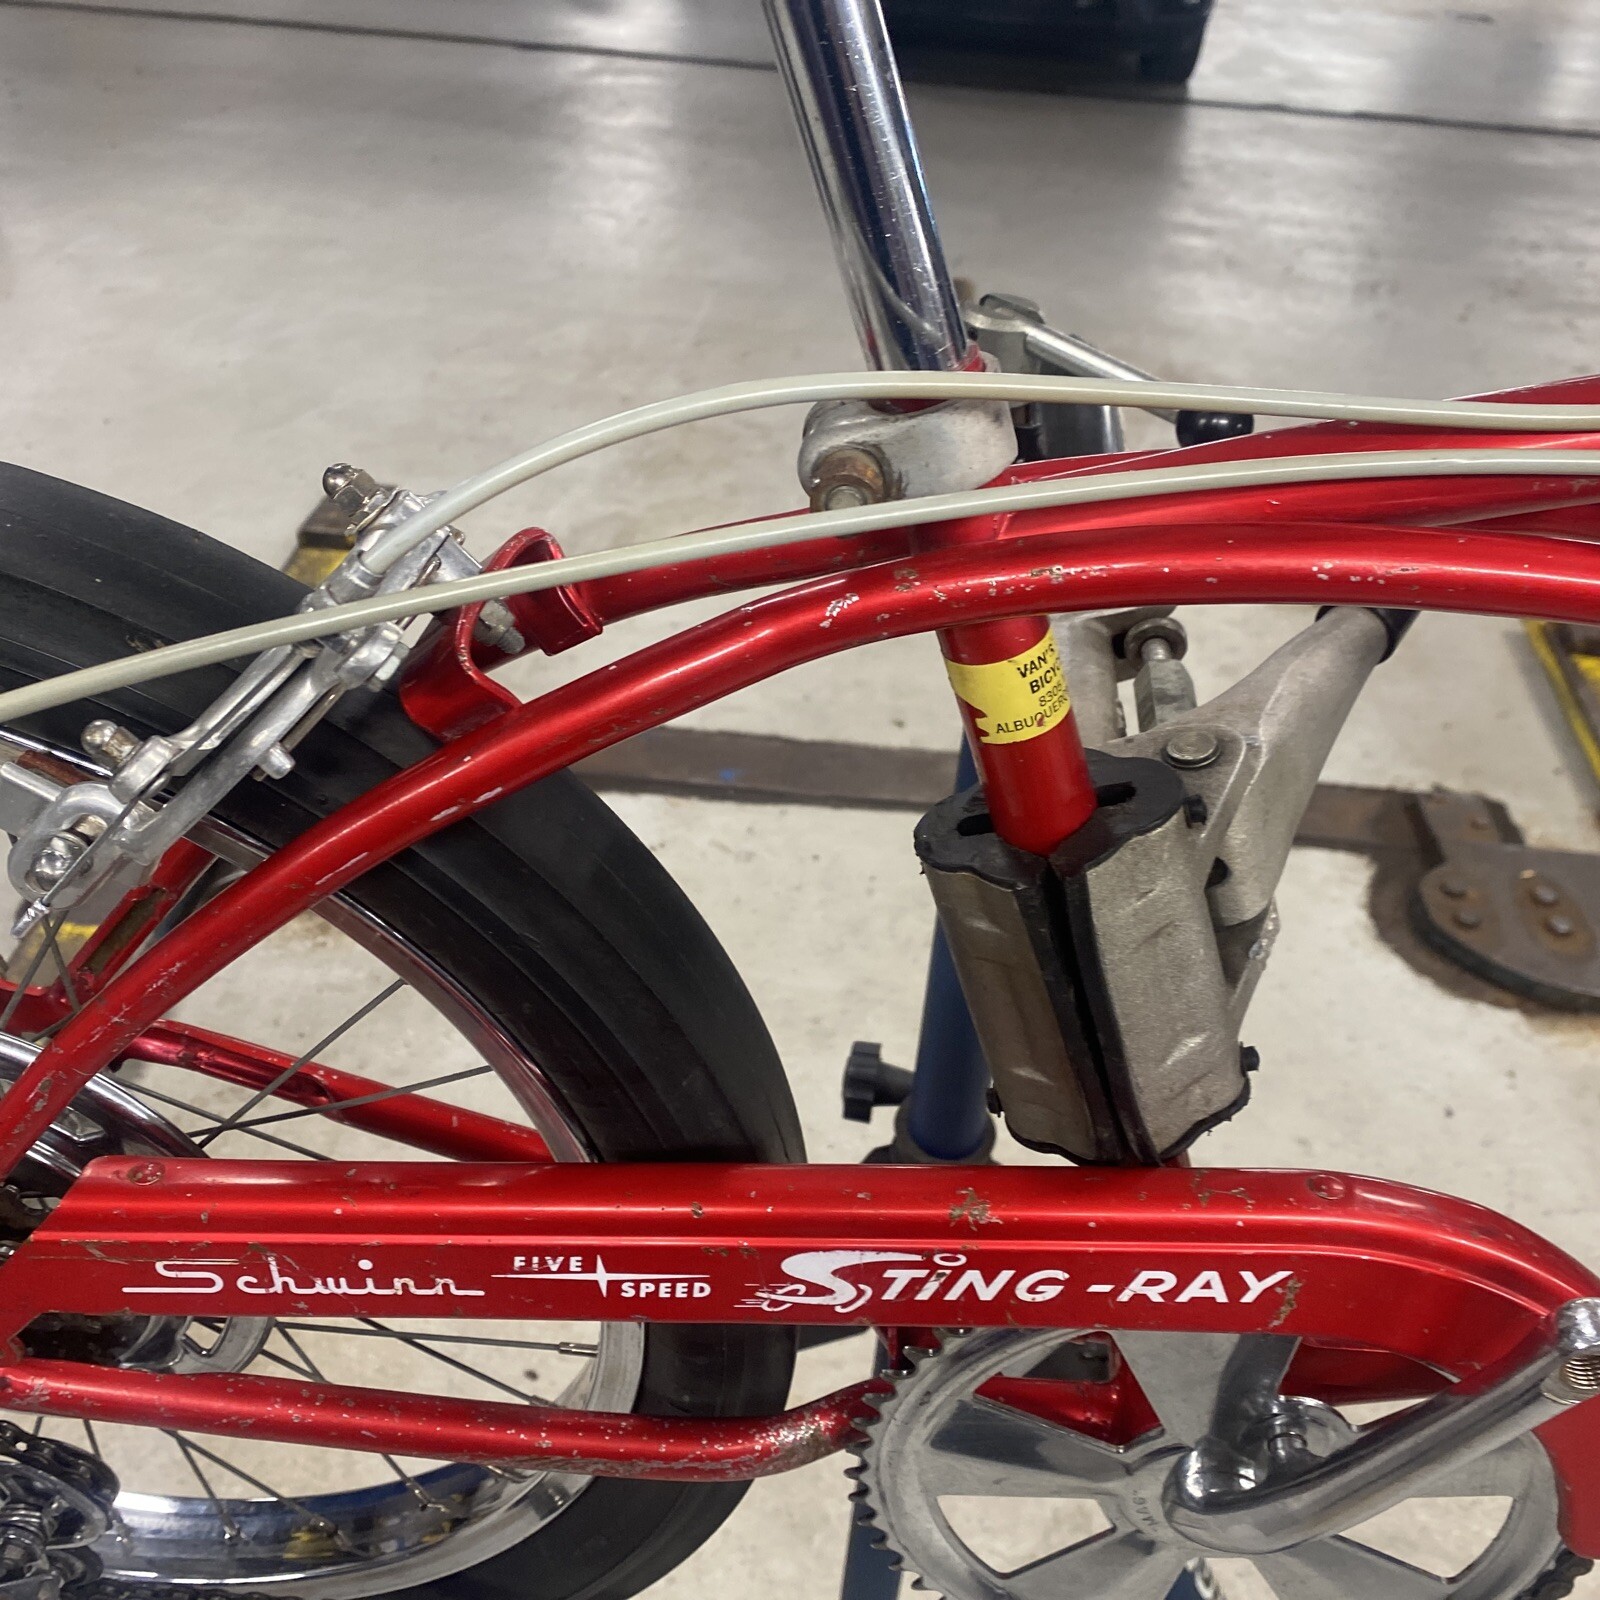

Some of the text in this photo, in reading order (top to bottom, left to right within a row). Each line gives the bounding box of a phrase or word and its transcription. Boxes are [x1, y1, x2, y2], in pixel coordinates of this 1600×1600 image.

[1017, 643, 1054, 678] VAN'S
[121, 1256, 486, 1296] Schwinn
[513, 1256, 583, 1272] FIVE
[620, 1282, 711, 1298] SPEED
